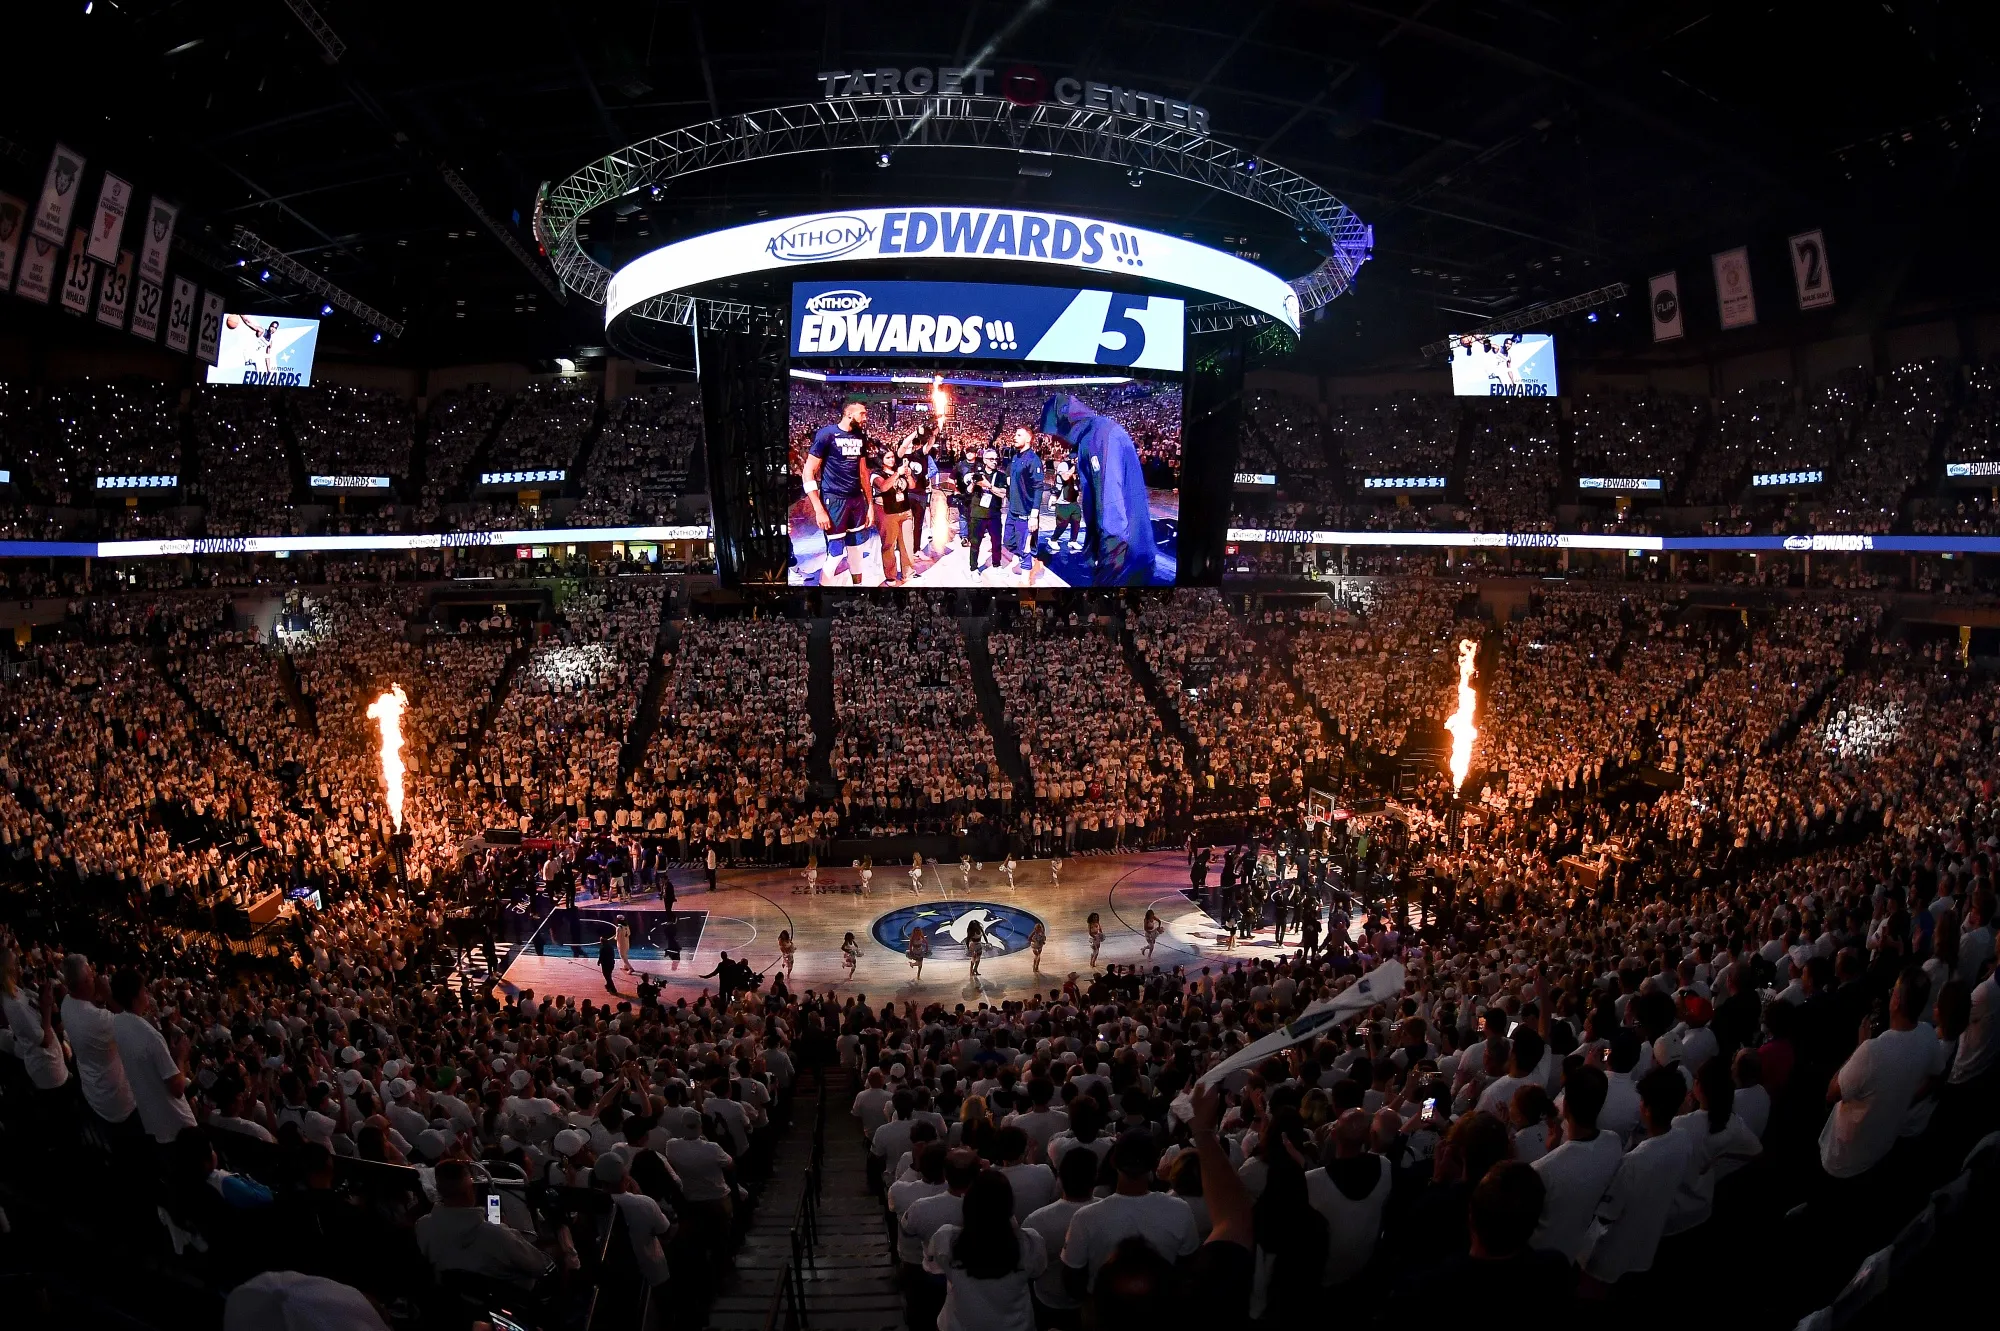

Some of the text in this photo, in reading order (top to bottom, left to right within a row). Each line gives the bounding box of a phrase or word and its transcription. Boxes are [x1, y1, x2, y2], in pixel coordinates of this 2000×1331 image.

[817, 67, 1211, 134] TARGET CENTER
[765, 226, 878, 253] ANTHONY
[69, 254, 91, 291] 13
[1796, 240, 1822, 290] 2
[105, 270, 126, 306] 33
[139, 284, 159, 319] 32
[805, 297, 872, 310] ANTHONY
[172, 299, 190, 332] 34
[1657, 300, 1675, 313] FLIP
[202, 313, 218, 343] 23
[1094, 292, 1149, 367] 5
[243, 371, 302, 386] EDWARDS
[1489, 383, 1548, 397] EDWARDS
[735, 860, 790, 868] Google
